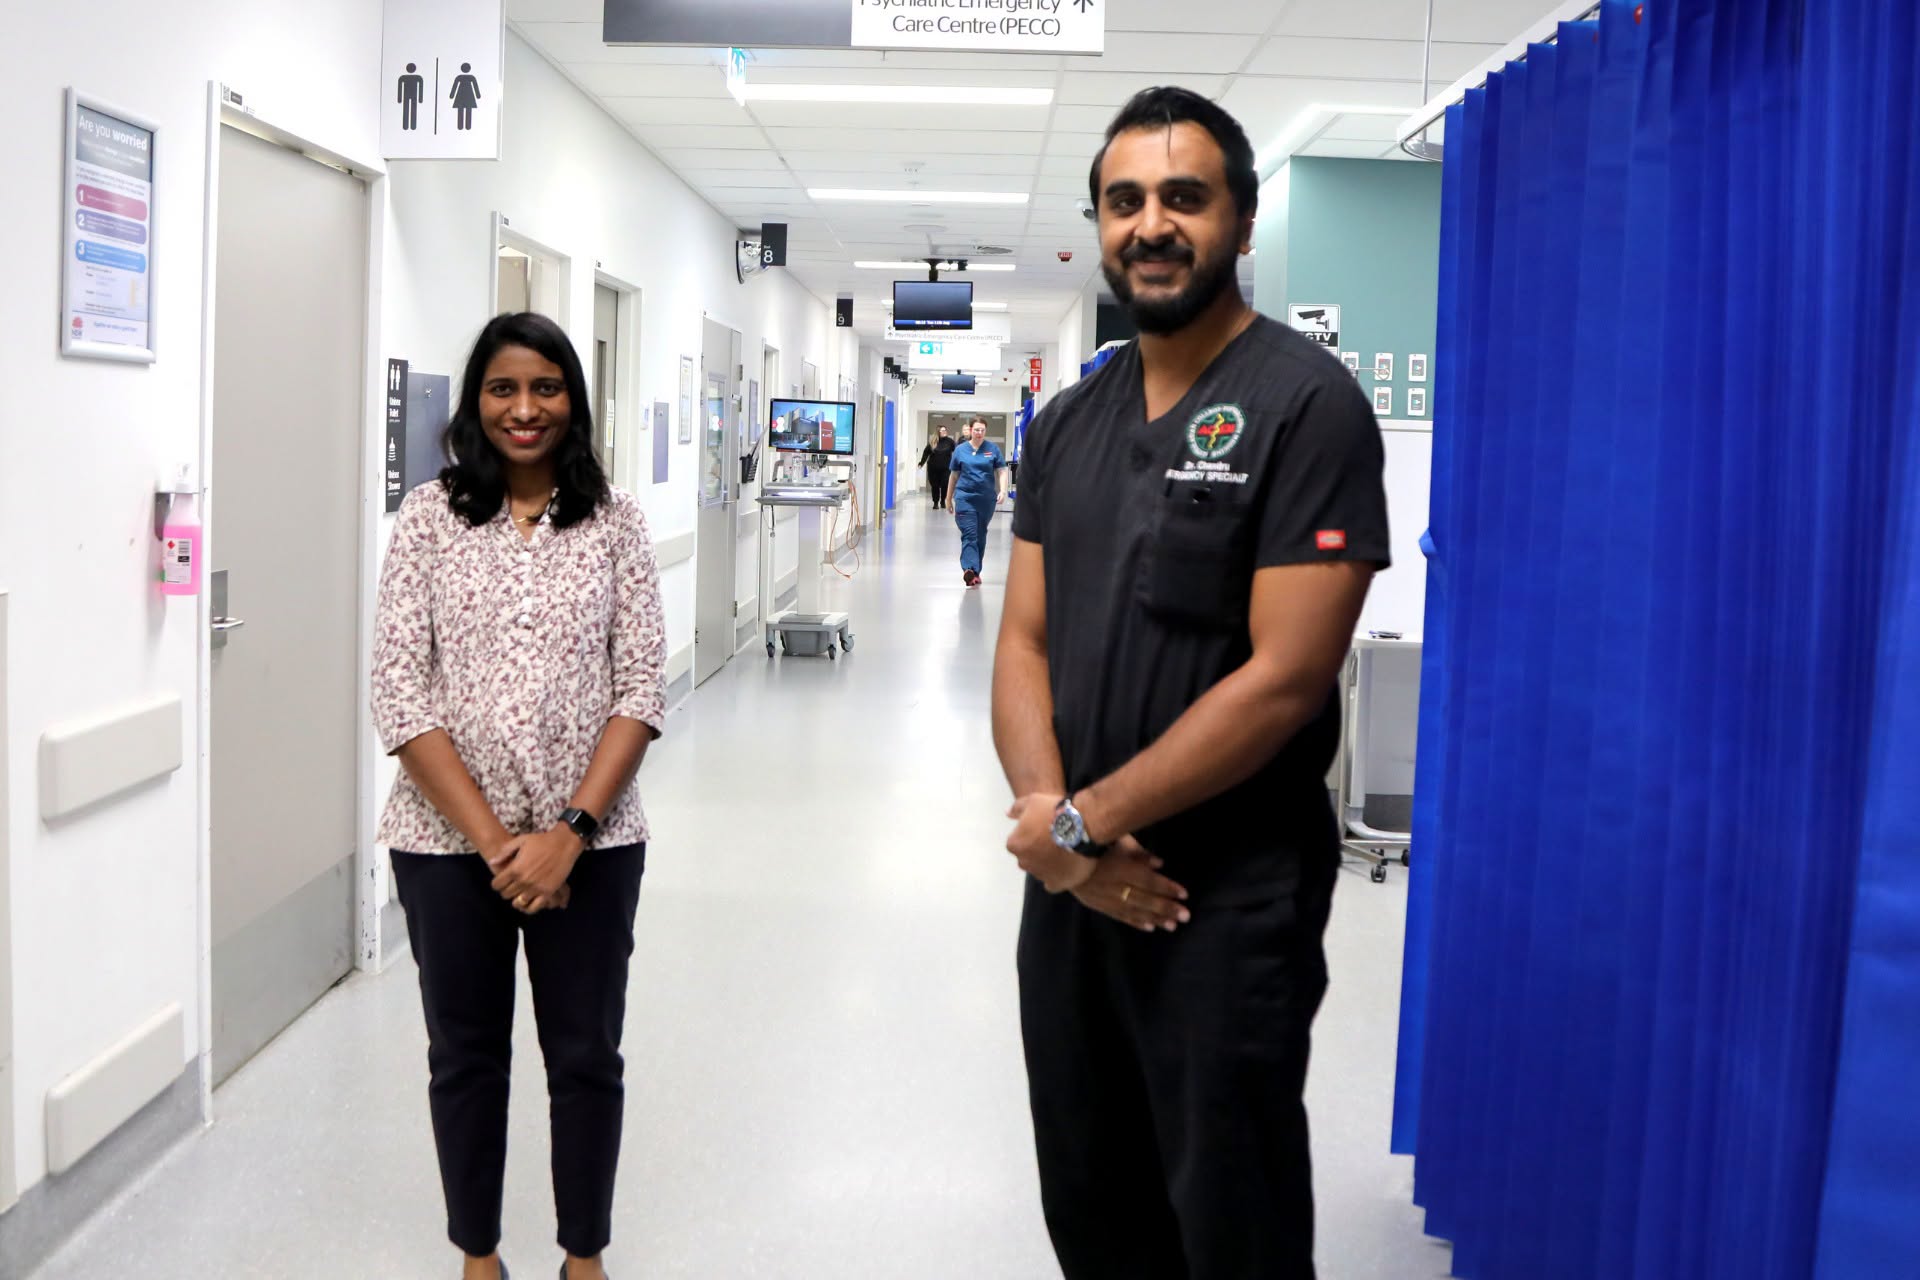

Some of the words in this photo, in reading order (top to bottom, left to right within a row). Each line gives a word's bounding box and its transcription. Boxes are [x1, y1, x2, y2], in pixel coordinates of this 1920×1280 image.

[892, 15, 934, 32] Care
[937, 16, 996, 34] Centre
[1000, 17, 1061, 36] (PECC)
[79, 115, 95, 132] Are
[95, 123, 111, 139] you
[112, 129, 148, 151] worried
[79, 189, 85, 202] 1
[78, 213, 85, 226] 2
[78, 241, 85, 255] 3
[764, 250, 773, 263] 8
[838, 316, 844, 326] 9
[1303, 332, 1332, 341] CTV
